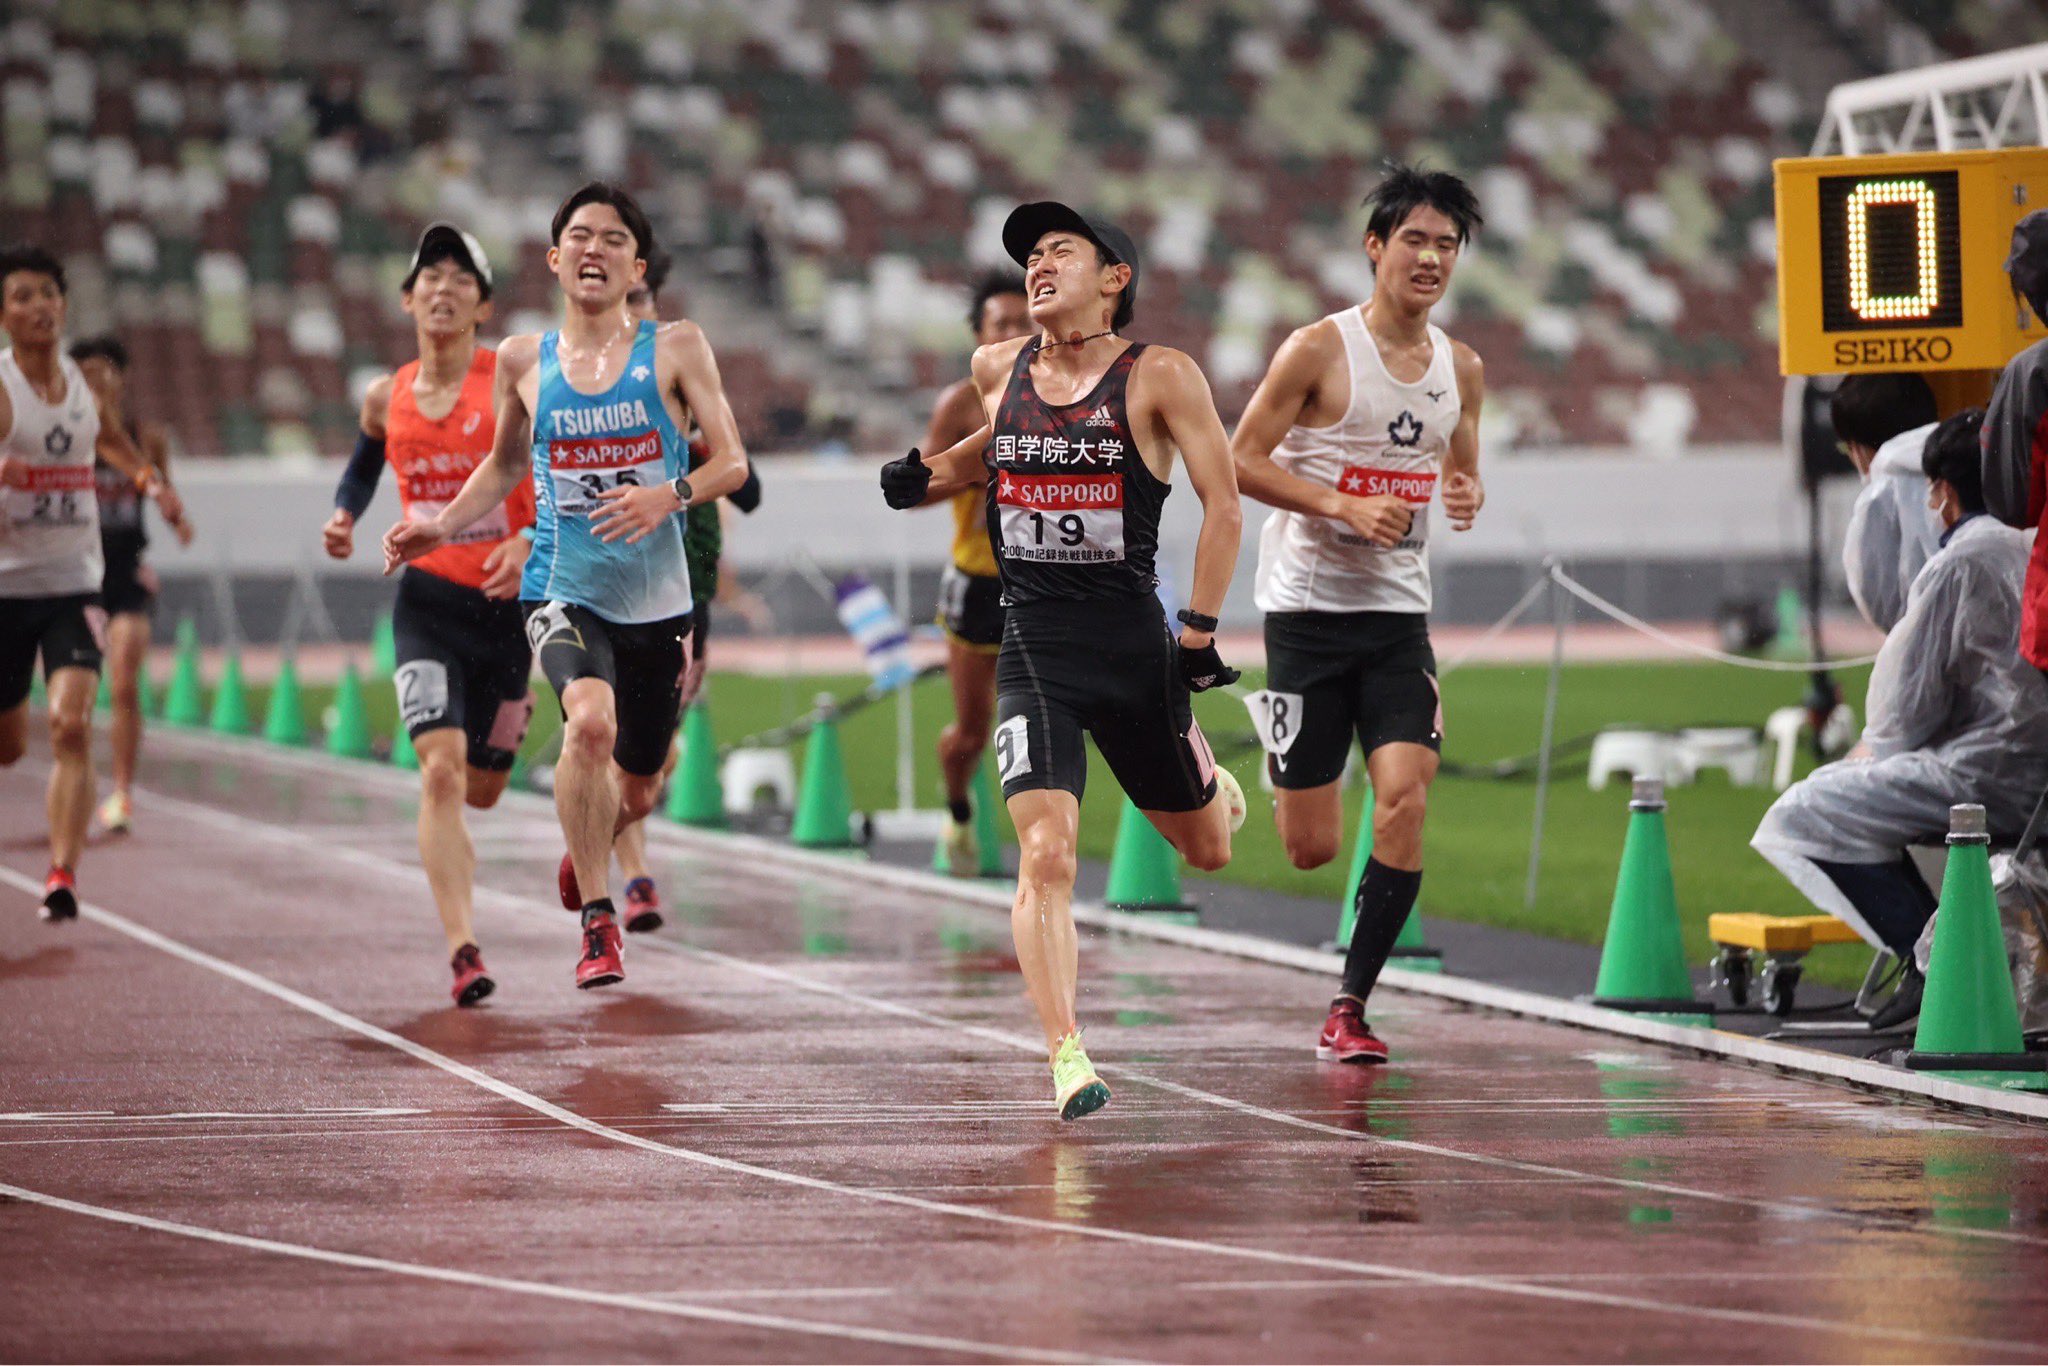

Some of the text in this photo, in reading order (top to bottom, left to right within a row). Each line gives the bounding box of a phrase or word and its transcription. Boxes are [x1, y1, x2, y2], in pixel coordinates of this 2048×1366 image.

[1848, 180, 1938, 319] 0
[1835, 337, 1952, 365] SEIKO
[550, 399, 649, 436] TSUKUBA
[1086, 418, 1115, 427] adidas
[574, 438, 657, 464] SAPPORO
[995, 434, 1124, 466] 国学院大学
[1020, 483, 1117, 503] SAPPORO
[1030, 512, 1084, 546] 19
